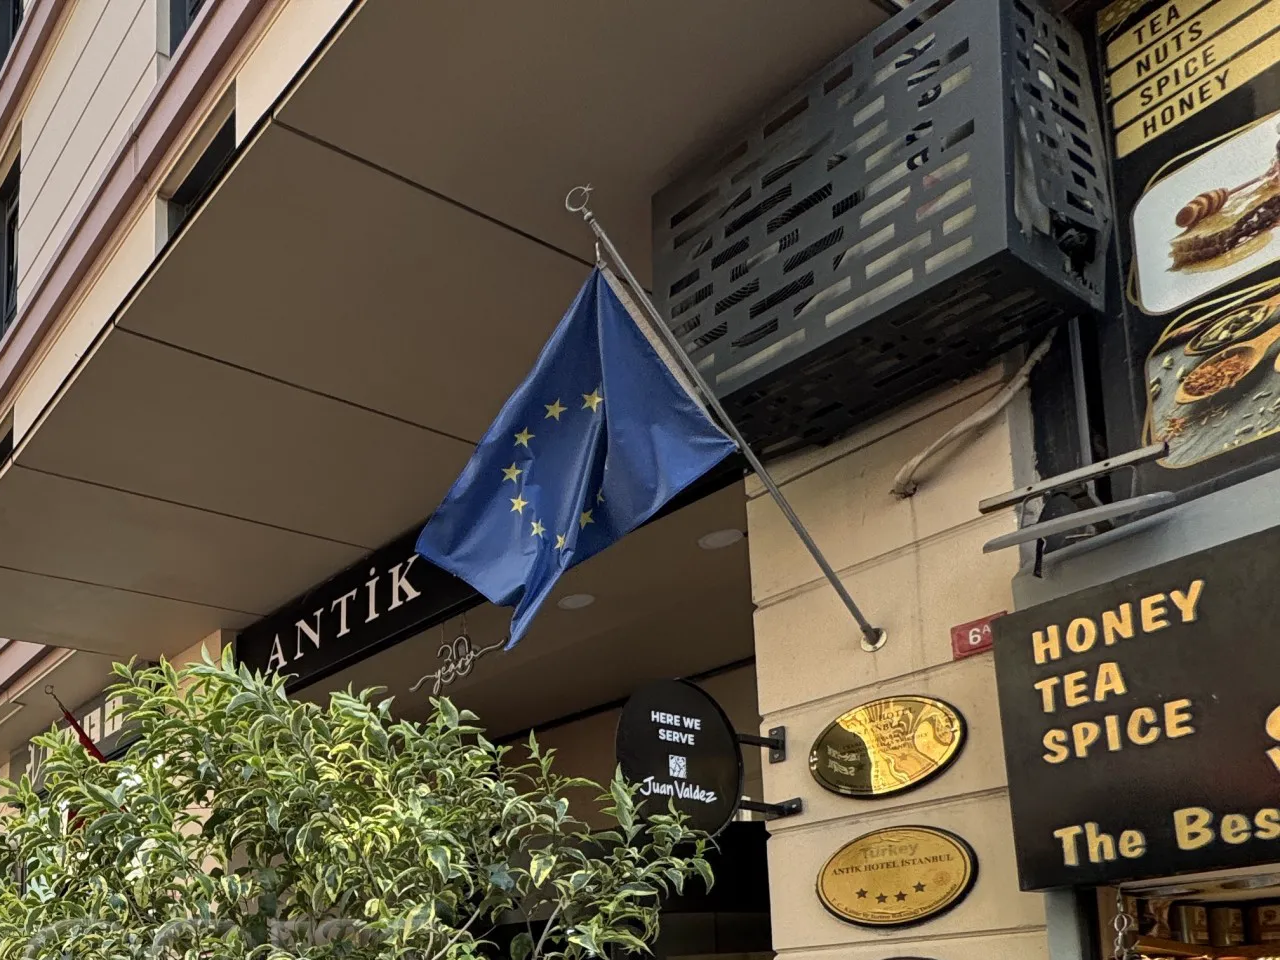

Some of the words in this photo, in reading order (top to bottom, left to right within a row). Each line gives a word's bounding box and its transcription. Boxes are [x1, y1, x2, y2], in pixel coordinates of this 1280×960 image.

[1132, 4, 1181, 45] TEA
[1136, 21, 1203, 78] NUTS
[1140, 44, 1217, 107] SPICE
[1143, 68, 1230, 139] HONEY
[264, 554, 422, 676] ANTİK
[1032, 579, 1205, 665] HONEY
[1034, 661, 1128, 714] TEA
[651, 710, 681, 727] HERE
[682, 716, 701, 730] WE
[658, 728, 695, 746] SERVE
[1042, 698, 1196, 765] SPICE
[640, 775, 674, 796] Juan
[674, 780, 718, 804] Valdez
[864, 861, 900, 873] HOTEL
[1053, 821, 1148, 867] The
